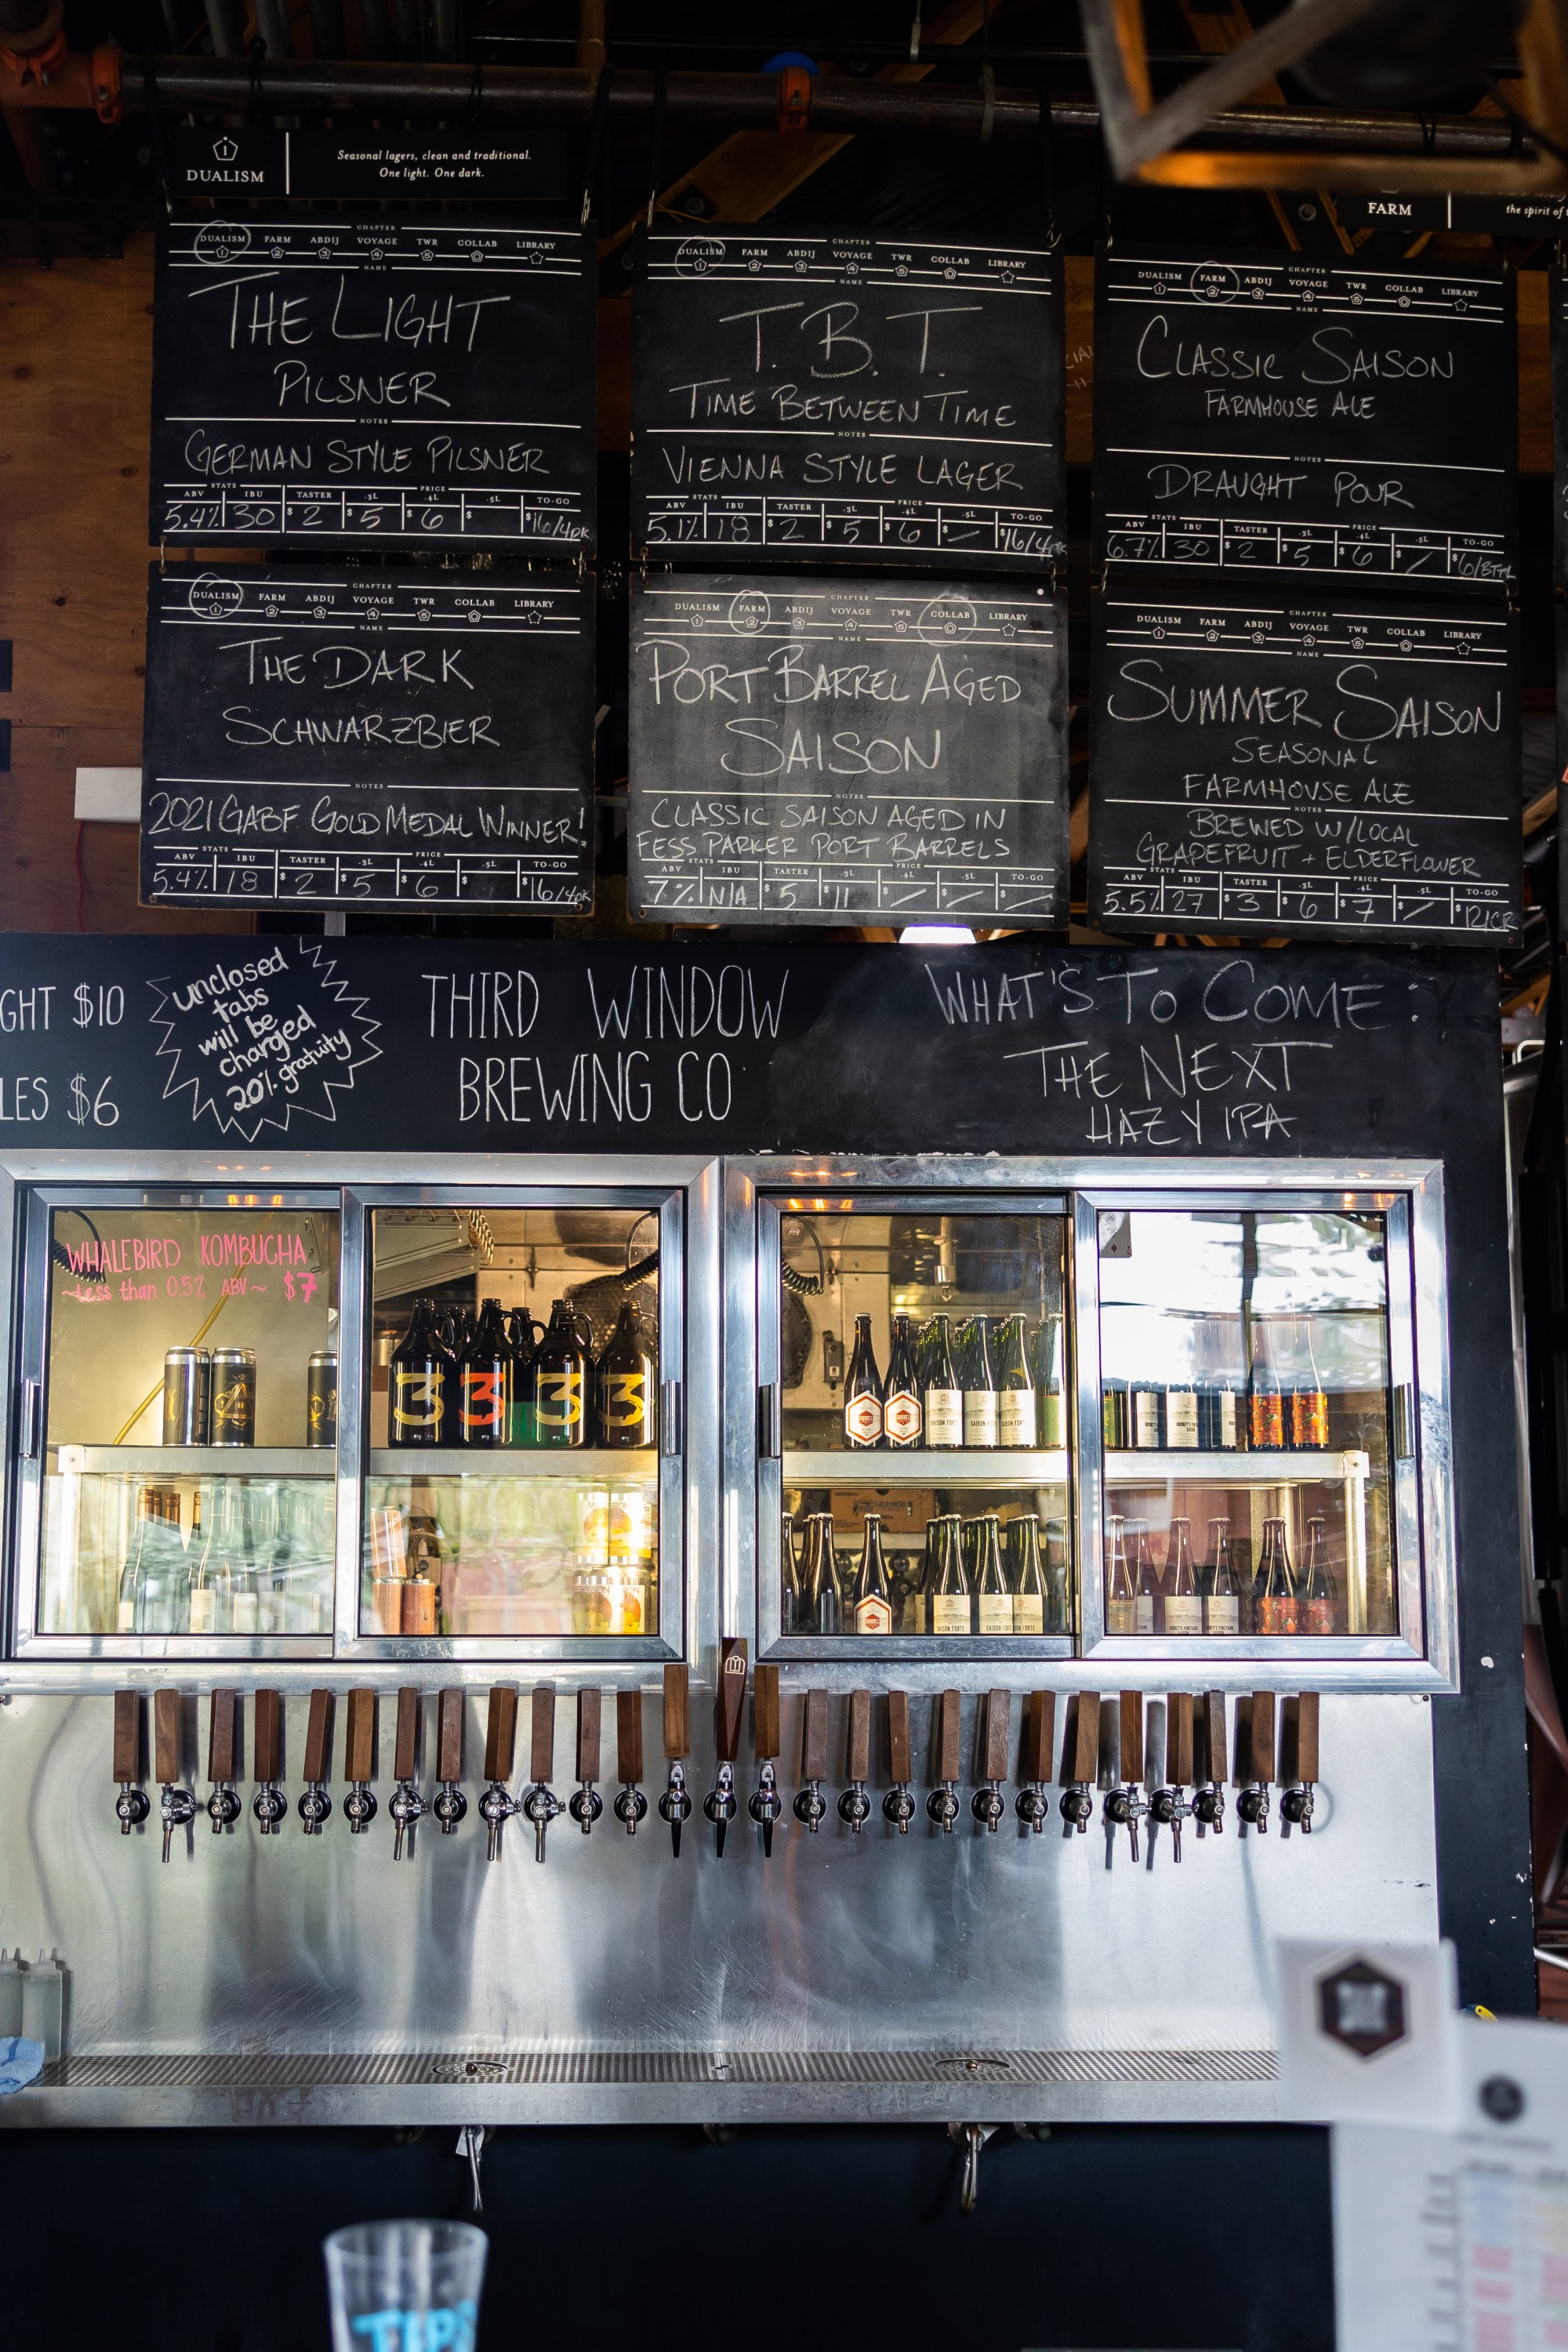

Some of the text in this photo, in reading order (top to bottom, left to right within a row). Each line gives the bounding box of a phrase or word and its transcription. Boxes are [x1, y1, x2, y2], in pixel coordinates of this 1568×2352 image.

[186, 169, 264, 183] DUALISM
[338, 149, 532, 163] Seasonal lagers, clean and traditional.
[379, 167, 485, 180] One light. One dark.
[1368, 202, 1412, 216] FARM
[1506, 205, 1565, 220] the spirit of
[201, 234, 245, 243] DUALISM
[517, 241, 556, 250] LIBRARY
[679, 248, 970, 265] DUALISM ABDIJ TWR COLLAB
[1244, 277, 1272, 286] ABDIJ
[1289, 278, 1329, 288] VOYAGE
[1442, 288, 1479, 297] LIBRARY
[332, 274, 511, 352] LIGHT
[1138, 315, 1454, 384] CLASSIC SAISON
[274, 361, 451, 407] PILSNER
[669, 378, 1016, 427] TIME BETWEEN TIME
[1204, 389, 1376, 419] FARMHOUSE ALE
[185, 429, 550, 476] GERMAN STYLE PILSNER
[662, 446, 1023, 491] VIENNA STYLE LAGER
[1147, 463, 1414, 509] DRAUGHT POUR
[233, 504, 275, 529] 30
[718, 516, 750, 543] 18
[1011, 513, 1043, 521] TO-GO
[1174, 539, 1210, 559] 30
[194, 591, 240, 600] DUALISM
[306, 595, 335, 604] ABDIJ
[514, 600, 554, 608] LIBRARY
[739, 604, 971, 619] FARM VOYAGE TWR COLLAB
[1137, 615, 1482, 640] DUALISM FARM COLLAB LIBRARY
[220, 637, 474, 689] THE DARK
[636, 639, 1021, 706] PORT BARREL AGED
[1107, 659, 1501, 742] SUMMER SAISON
[223, 706, 500, 749] SCHWARZBIER
[720, 717, 941, 777] SAISON
[1232, 736, 1378, 768] SEASONAL
[1182, 772, 1414, 805] FARMHOUSE ALE
[148, 792, 213, 834] 2021
[219, 794, 301, 835] GABF
[311, 795, 380, 835] GOLD
[386, 804, 473, 837] MEDAL
[651, 798, 1006, 832] CLASSIC SAISON AGED IN
[1186, 808, 1304, 838] BREWED
[636, 830, 1011, 862] FESS PARKER PORT BARRELS
[1137, 831, 1481, 878] GRAPEFRUIT ELDERFLOWER
[227, 870, 258, 895] 18
[709, 882, 746, 908] N/A
[1172, 891, 1203, 914] 27
[172, 946, 289, 1011] unclosed
[924, 964, 1094, 1025] WHAT'S
[1097, 967, 1177, 1024] TO
[73, 982, 125, 1028] $10
[212, 986, 270, 1023] tabs
[422, 964, 789, 1039] THIRD WINDOW
[198, 1012, 278, 1055] will be
[220, 1004, 317, 1078] charged
[226, 1028, 352, 1112] 20% gratuity
[459, 1051, 731, 1123] BREWING CO
[1003, 1033, 1334, 1101] THE NEXT
[67, 1073, 119, 1127] $6
[1085, 1100, 1298, 1145] HAZY IPA
[66, 1233, 307, 1273] WHALEBIRD KOMBUCHA
[118, 1278, 157, 1301] than
[221, 1276, 248, 1296] ABV
[283, 1270, 318, 1302] $7
[394, 1372, 445, 1426] 3
[459, 1372, 506, 1426] 3
[534, 1372, 585, 1426] 3
[598, 1374, 645, 1426] 3
